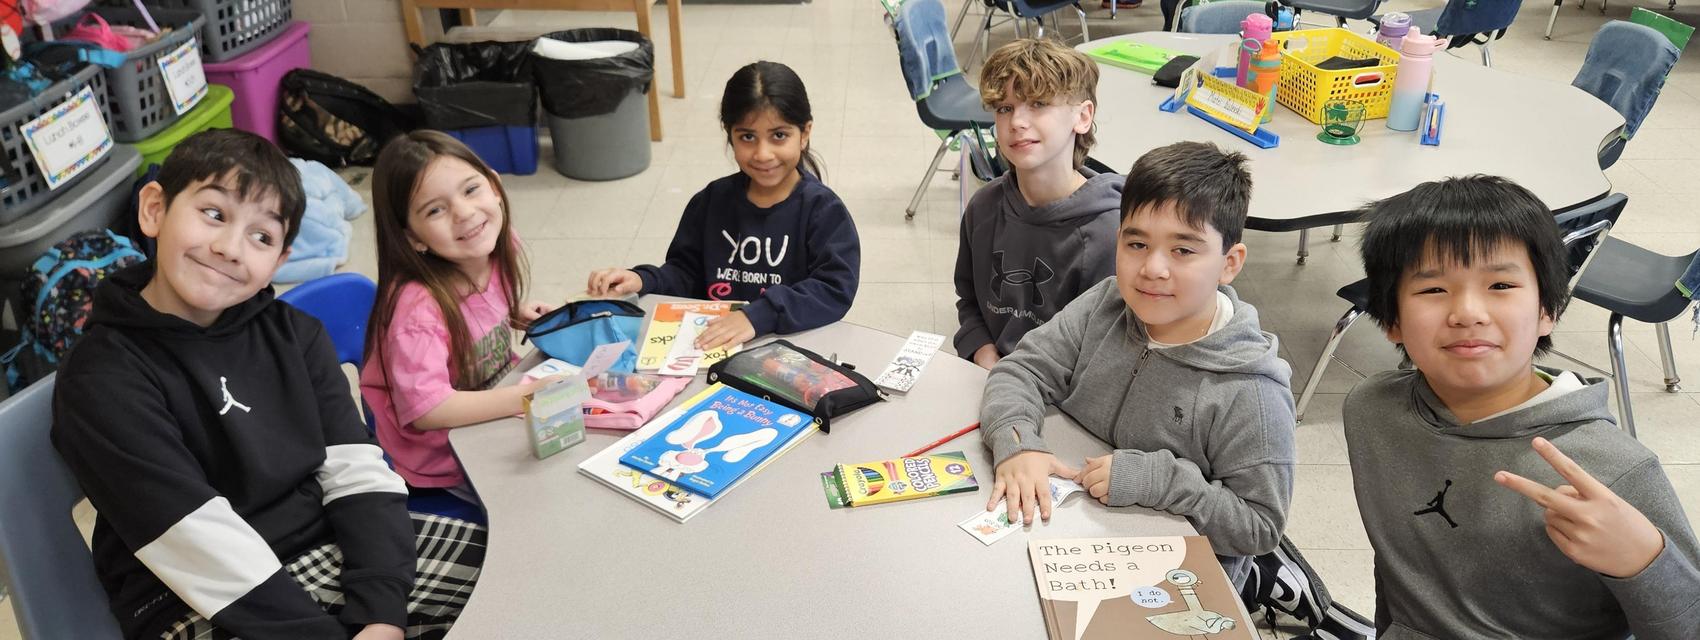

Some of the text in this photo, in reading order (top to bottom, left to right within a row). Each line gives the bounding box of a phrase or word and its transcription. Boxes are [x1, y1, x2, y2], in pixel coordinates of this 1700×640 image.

[721, 229, 789, 267] YOU
[742, 271, 767, 284] BORN
[769, 273, 782, 285] TO
[650, 334, 677, 345] cks
[704, 350, 730, 360] Fox
[710, 401, 738, 415] Being
[743, 410, 774, 426] Bunny
[738, 399, 755, 408] Not
[754, 404, 774, 415] Easy
[904, 458, 927, 492] COLORED
[915, 458, 941, 490] PENCILS
[949, 464, 961, 474] 12
[853, 469, 868, 495] Crayola
[1039, 542, 1174, 557] The Pigeon
[1044, 560, 1140, 574] Needs a
[1049, 577, 1117, 592] Bath!
[1149, 589, 1162, 597] do
